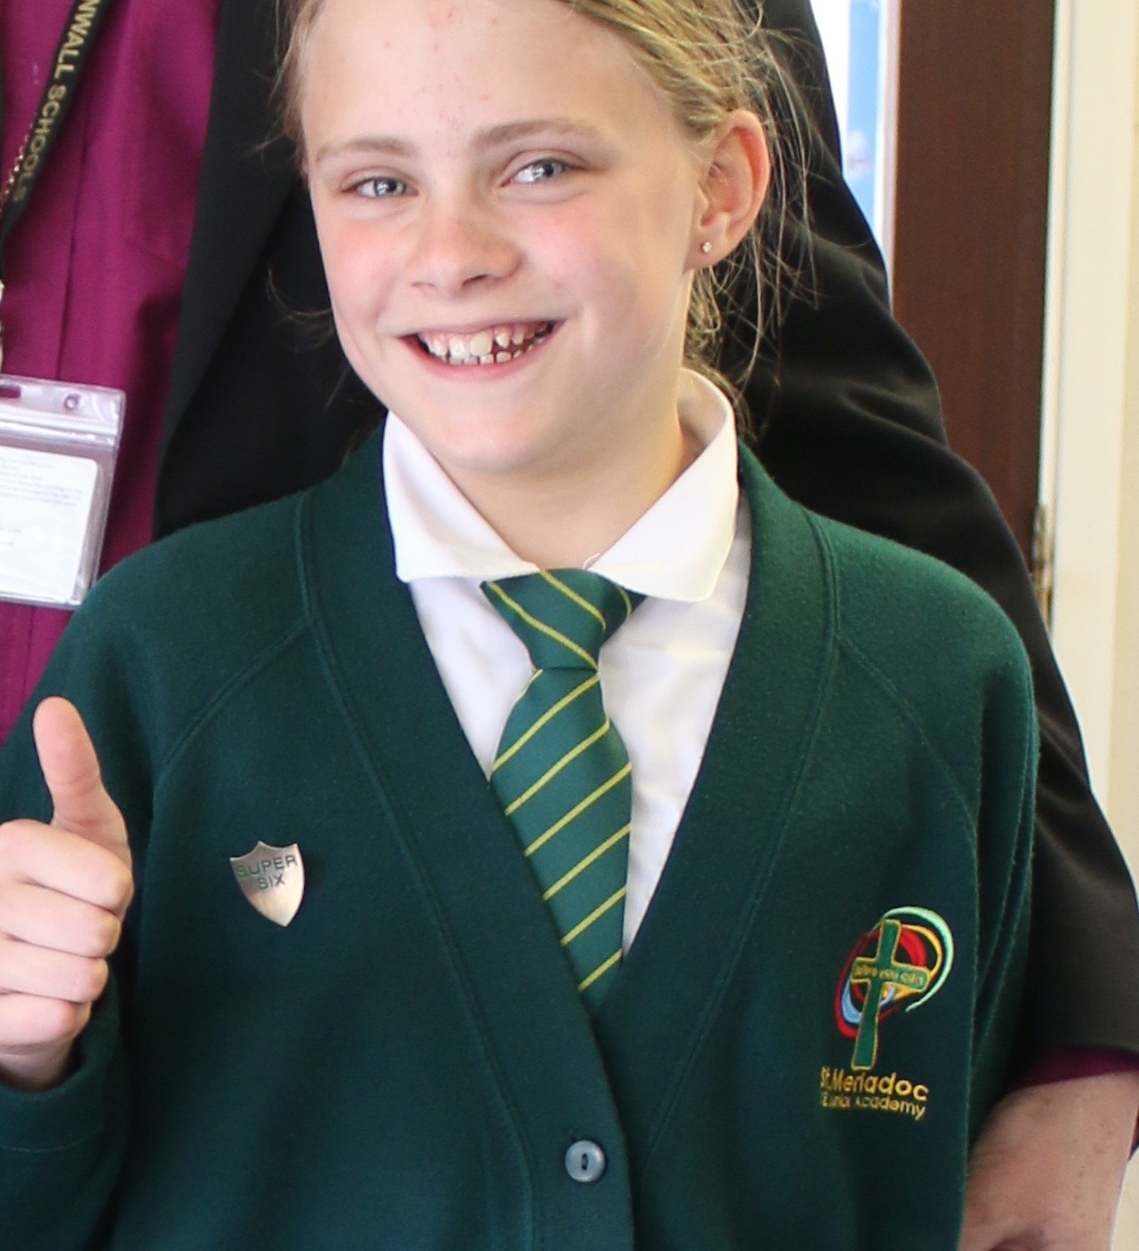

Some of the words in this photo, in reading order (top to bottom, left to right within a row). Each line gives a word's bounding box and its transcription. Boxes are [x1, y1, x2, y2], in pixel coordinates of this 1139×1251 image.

[13, 84, 67, 202] SCHOOLS
[236, 855, 297, 878] SUPER
[258, 873, 286, 890] SIX
